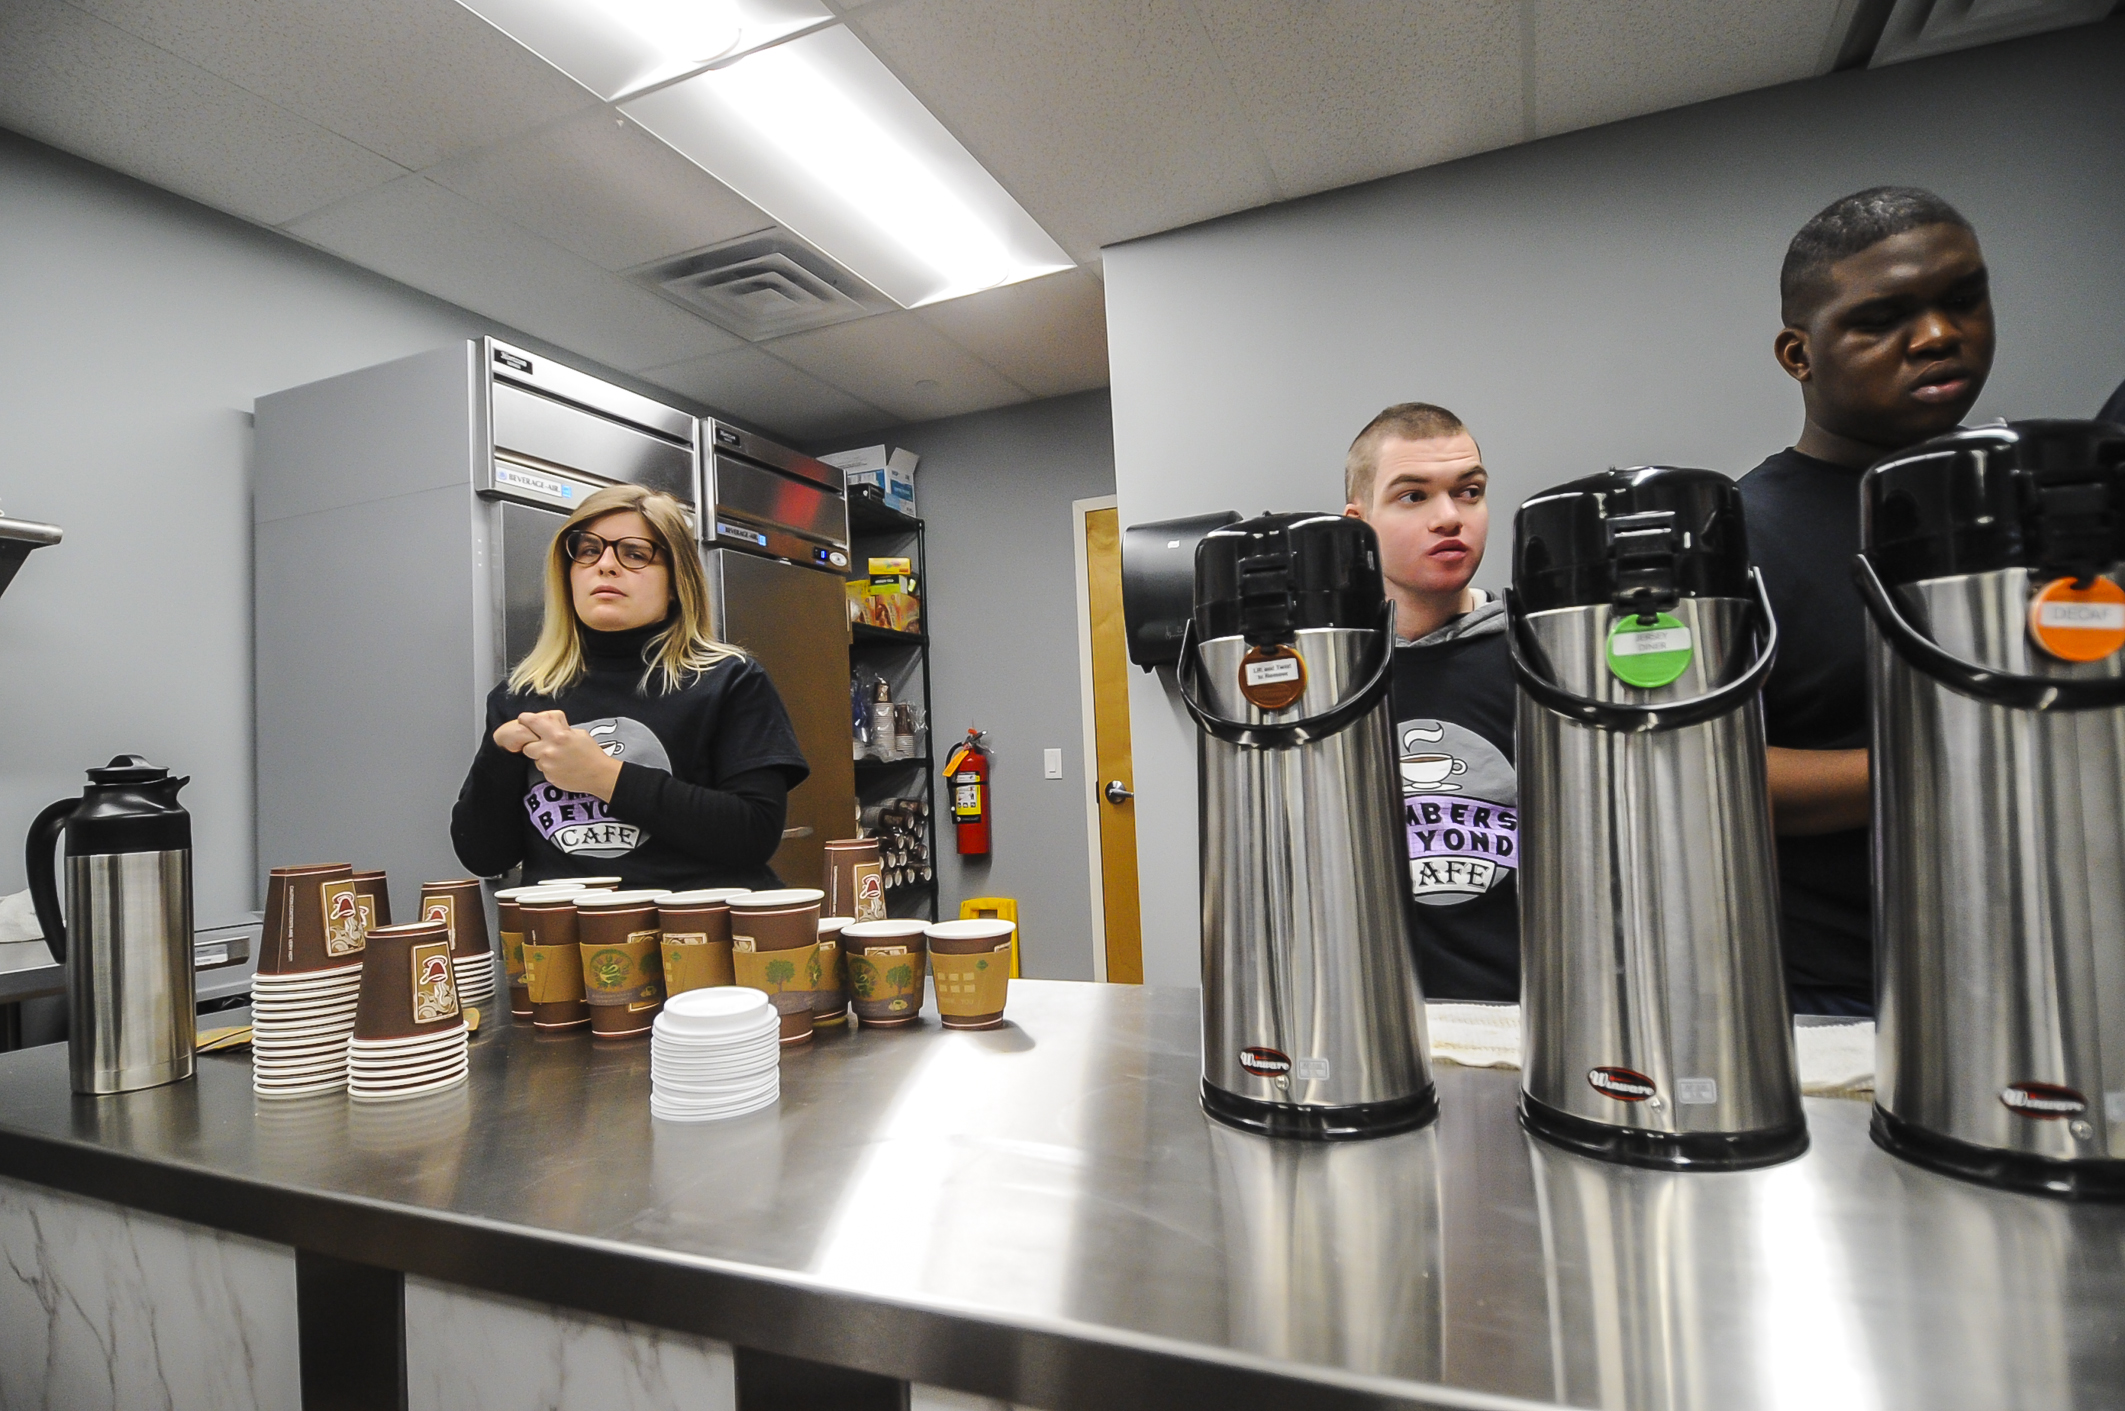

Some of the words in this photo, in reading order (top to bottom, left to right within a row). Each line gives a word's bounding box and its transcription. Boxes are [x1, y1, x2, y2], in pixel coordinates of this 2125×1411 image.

[2054, 606, 2111, 621] DECAF
[1636, 632, 1668, 642] JERSEY
[1637, 642, 1667, 652] DINER
[561, 825, 637, 847] CAFE
[1414, 828, 1514, 857] YOND
[1418, 860, 1491, 890] AFE
